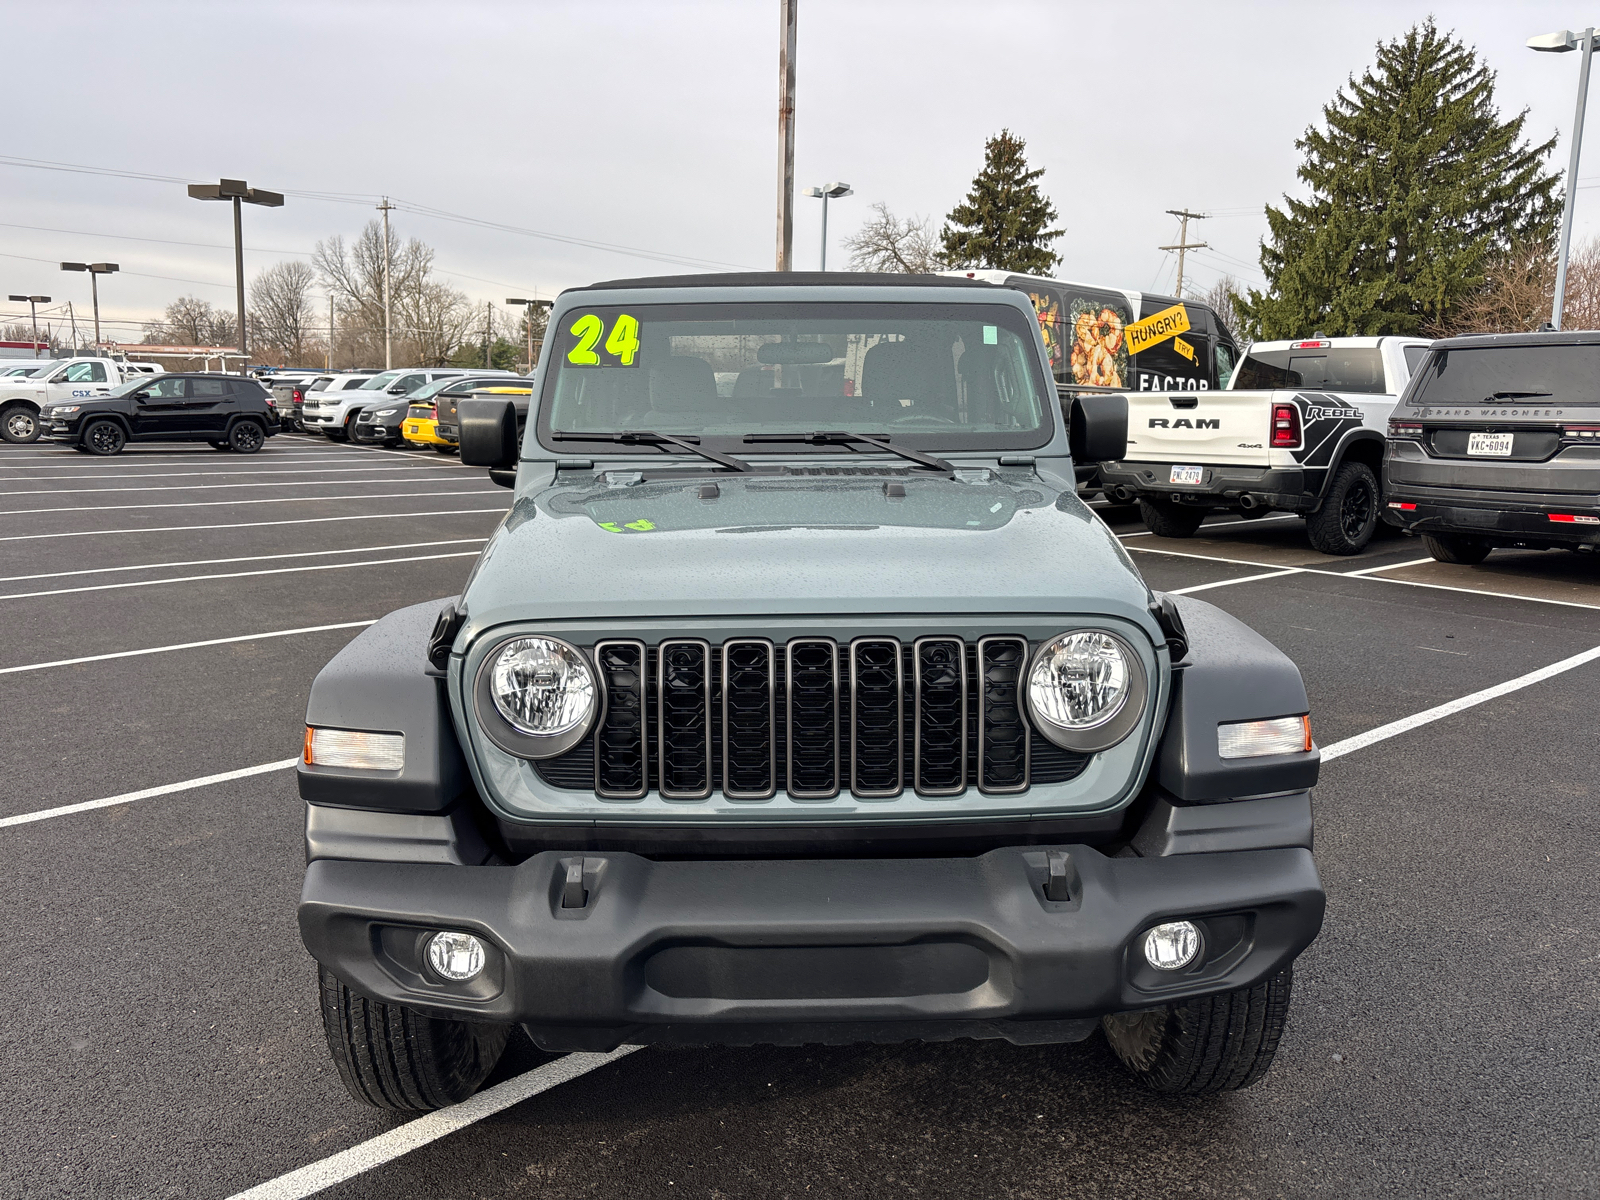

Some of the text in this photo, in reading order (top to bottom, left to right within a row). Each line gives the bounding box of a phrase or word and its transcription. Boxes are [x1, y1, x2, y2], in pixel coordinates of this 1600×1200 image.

[1130, 312, 1183, 346] HUNGRY?
[568, 314, 640, 366] 24
[1177, 341, 1191, 355] TRY
[1305, 405, 1364, 420] REBEL
[1148, 418, 1220, 429] RAM
